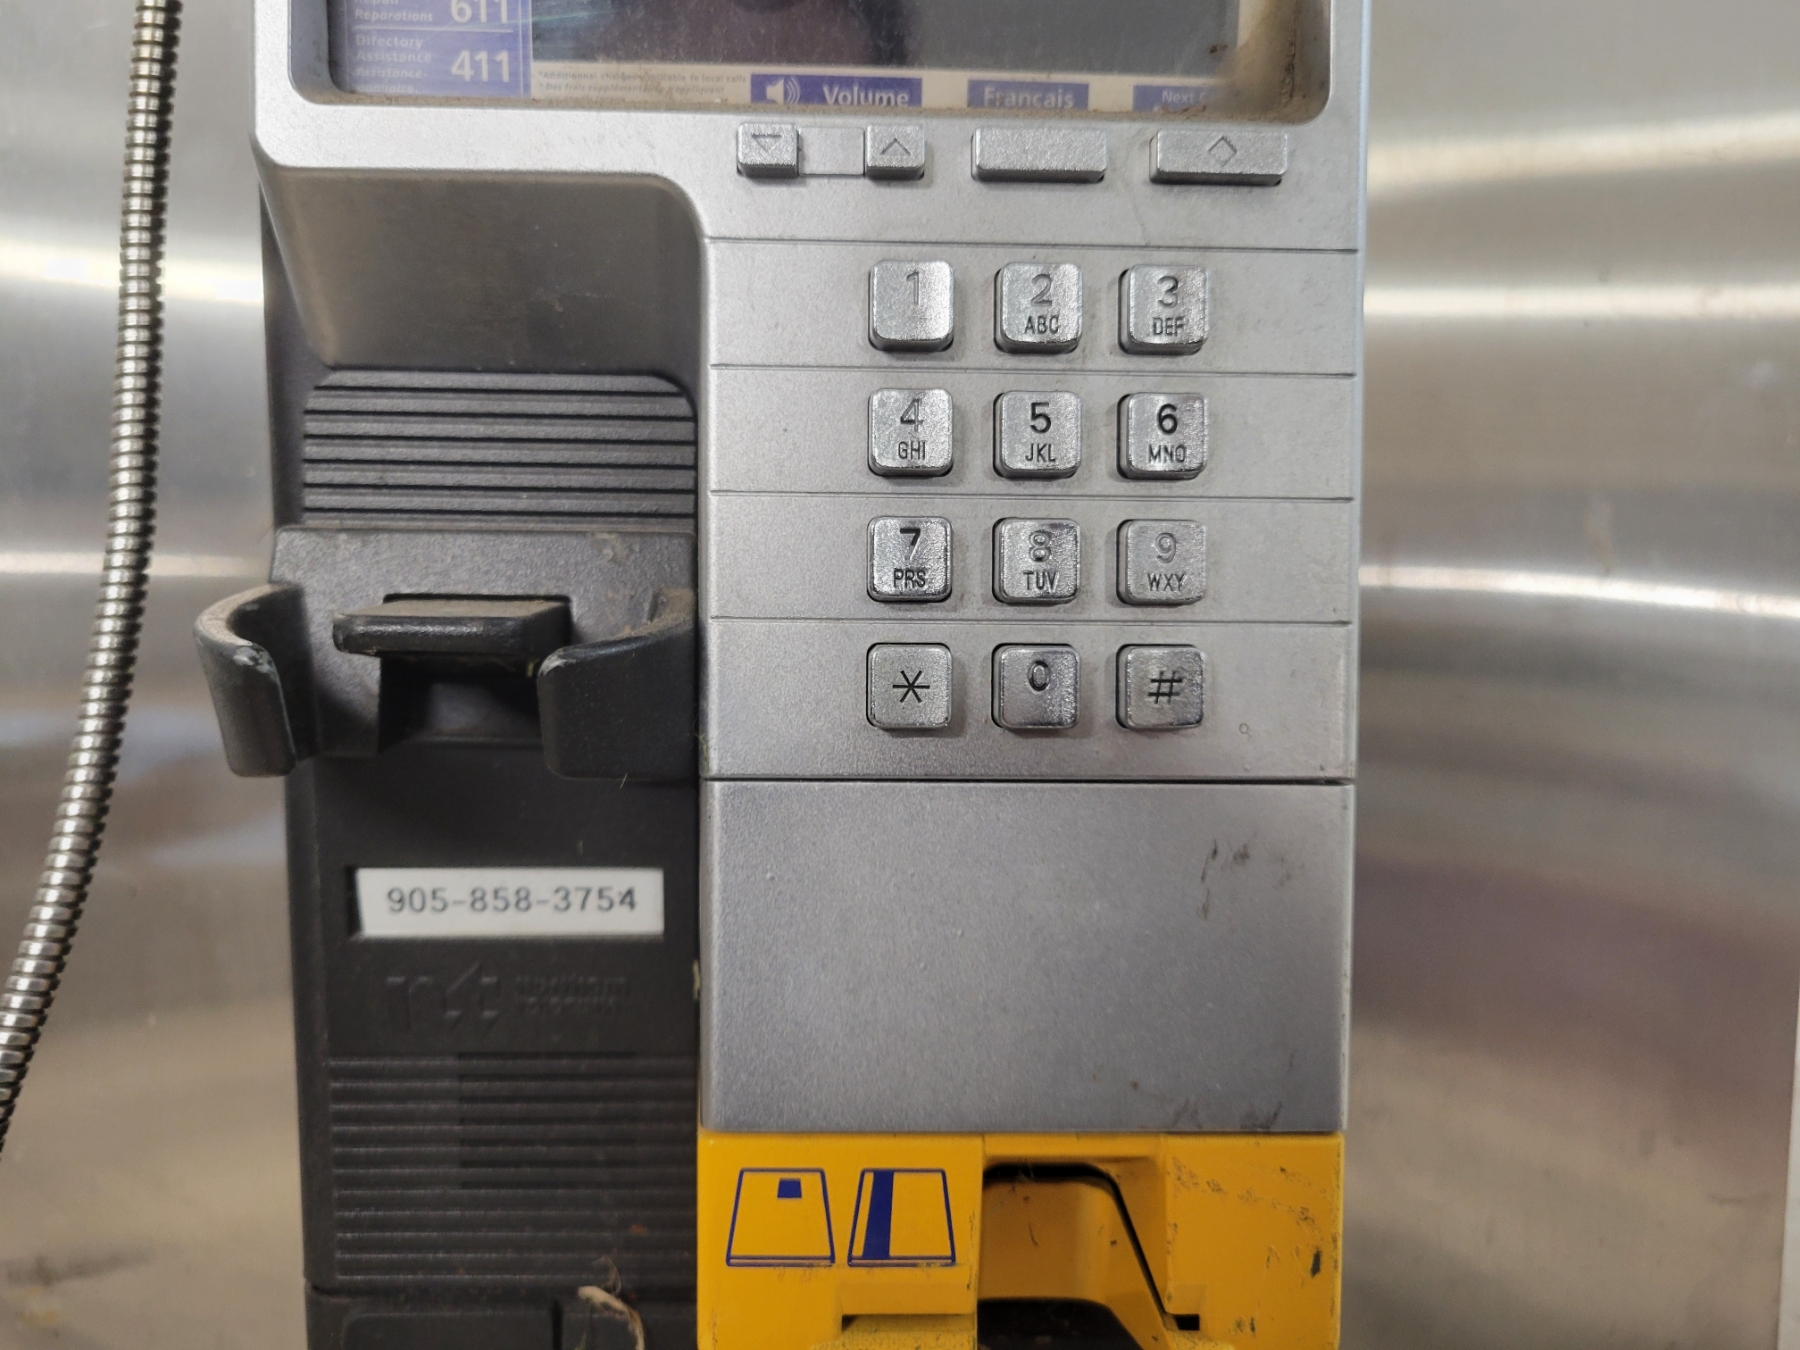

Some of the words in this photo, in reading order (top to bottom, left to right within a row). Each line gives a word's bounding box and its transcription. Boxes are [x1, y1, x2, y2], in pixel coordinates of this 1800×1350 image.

[451, 0, 509, 24] 611
[355, 33, 423, 51] Directory
[356, 50, 432, 64] Assistance
[450, 50, 510, 83] 411
[822, 83, 909, 108] Volume
[1161, 90, 1194, 104] Next
[905, 269, 920, 306] 1
[1030, 273, 1053, 307] 2
[1156, 274, 1180, 309] 3
[1024, 315, 1060, 336] ABC
[1152, 316, 1186, 337] DEF
[900, 399, 925, 433] 4
[1030, 401, 1052, 434] 5
[1156, 403, 1180, 436] 6
[897, 440, 926, 461] GHI
[1024, 441, 1057, 463] JKL
[1148, 443, 1187, 463] MNO
[899, 527, 922, 561] 7
[1028, 529, 1052, 563] 8
[1154, 532, 1178, 564] 9
[893, 568, 927, 588] PRS
[1022, 570, 1060, 592] TUV
[1147, 572, 1186, 593] WXY
[1147, 670, 1184, 705] #
[386, 885, 639, 914] 905-858-3754
